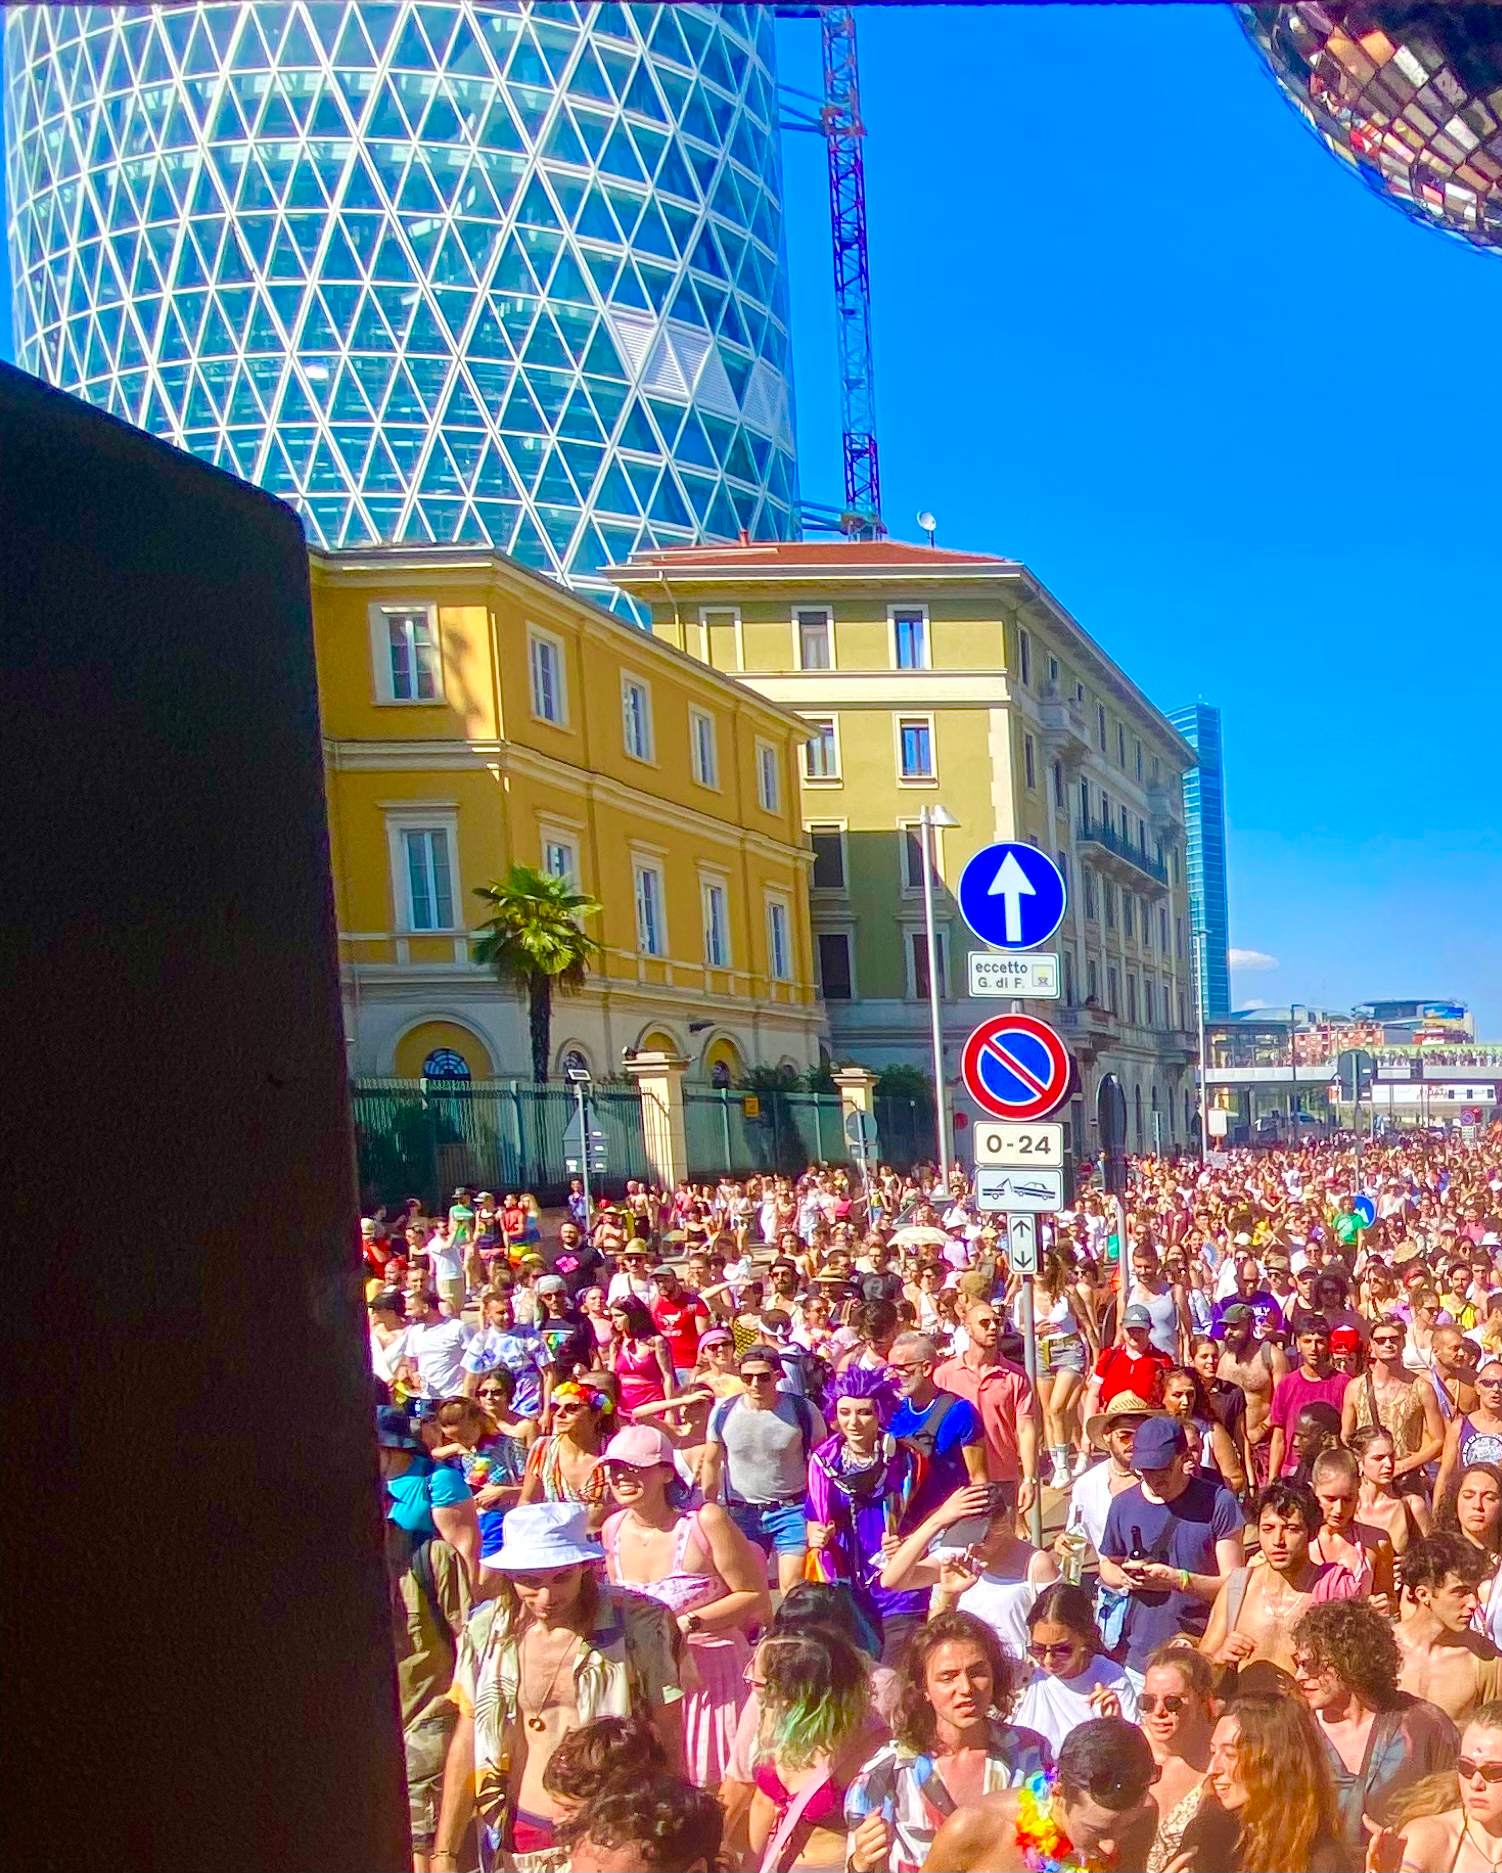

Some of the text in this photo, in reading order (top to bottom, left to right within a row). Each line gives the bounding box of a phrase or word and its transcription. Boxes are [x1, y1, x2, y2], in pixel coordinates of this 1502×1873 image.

[975, 961, 1029, 974] eccetto
[978, 976, 1026, 989] G. di F.
